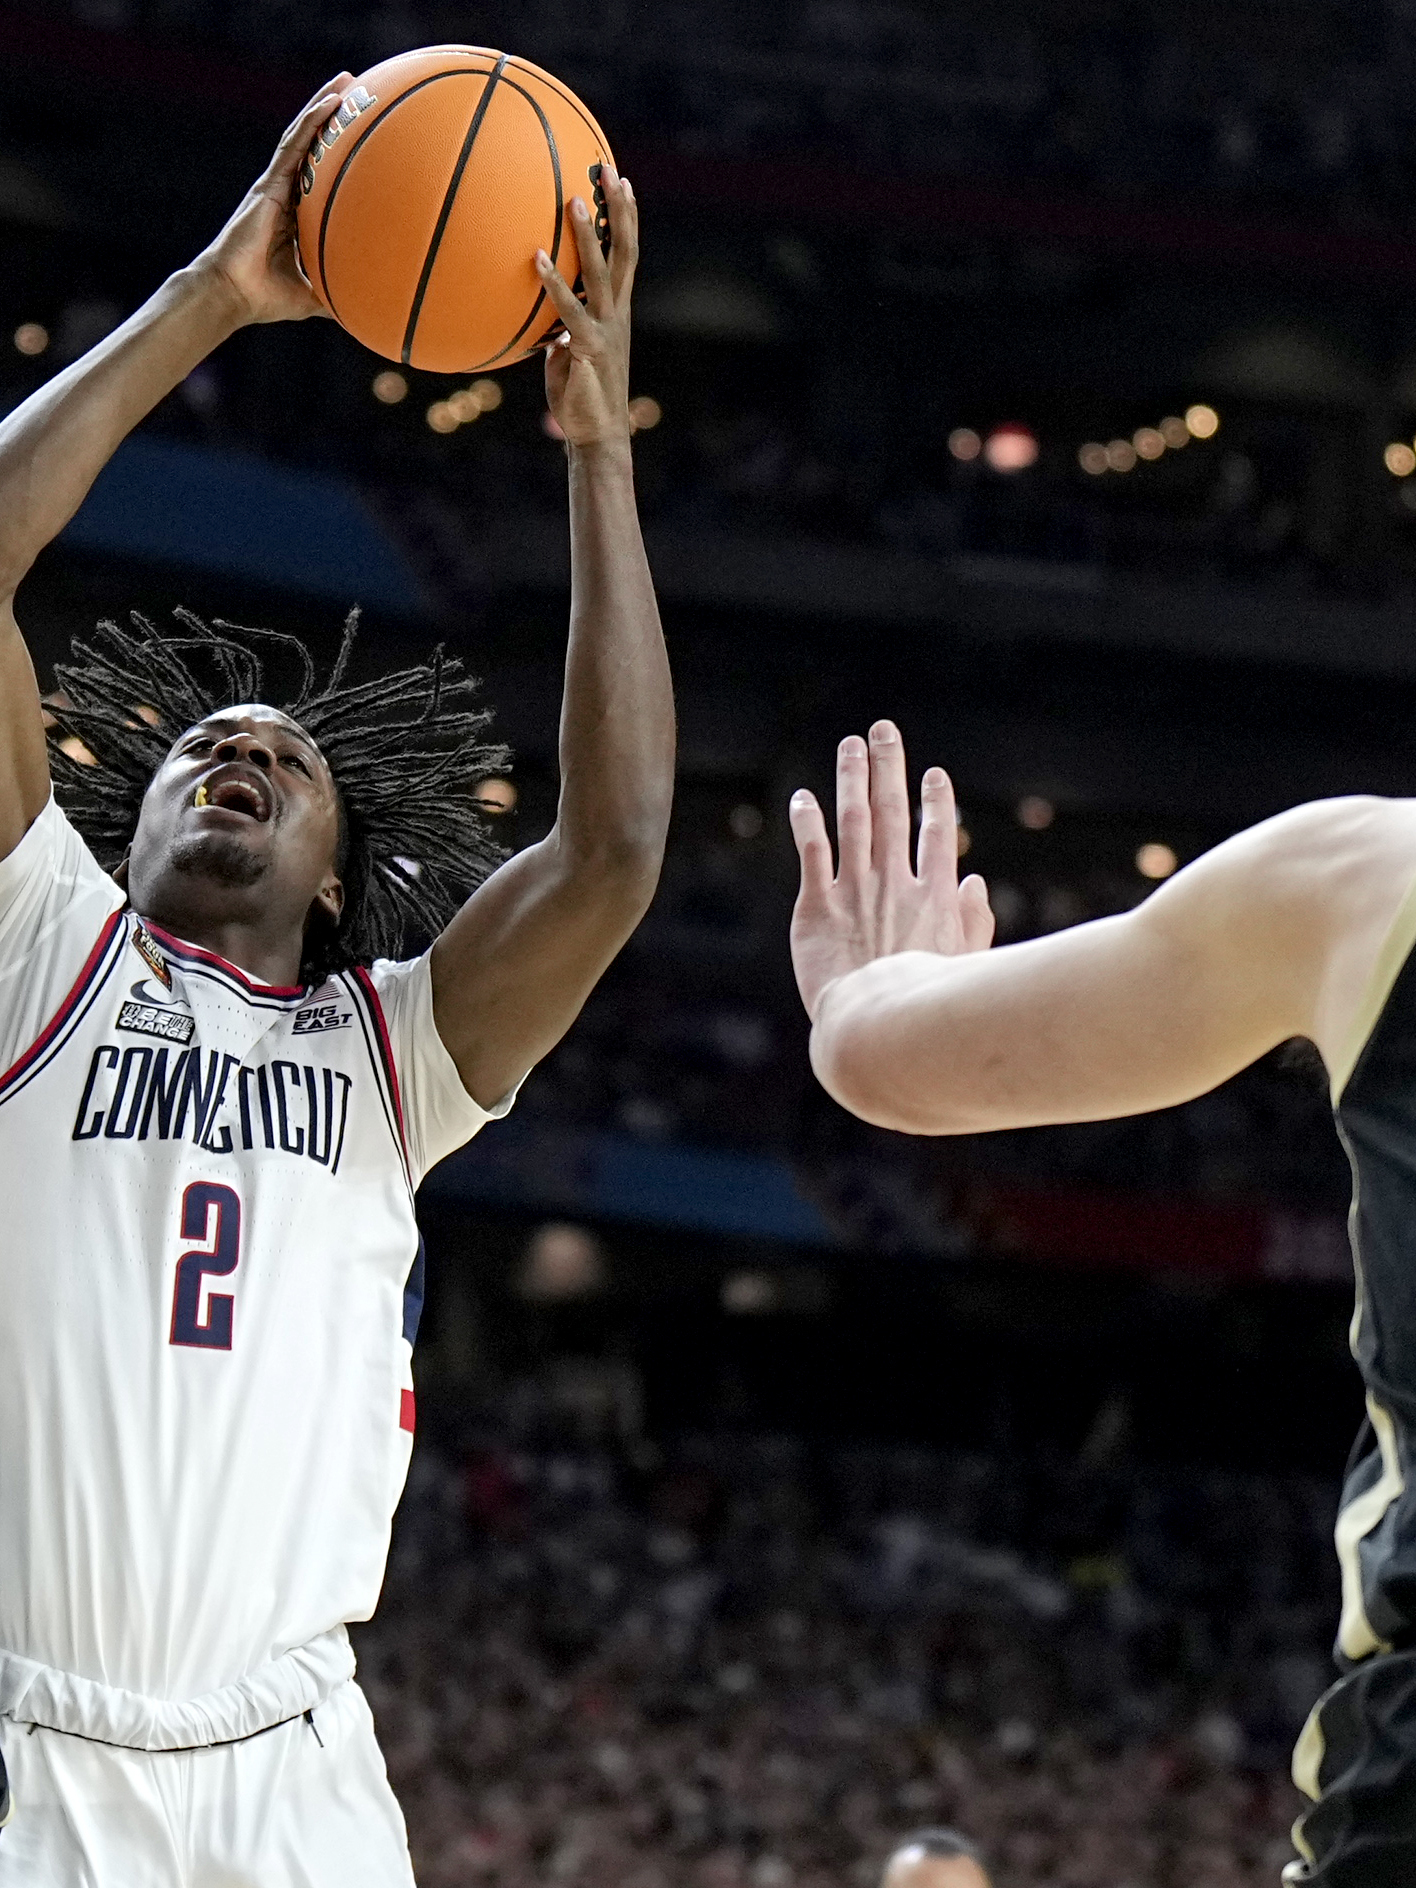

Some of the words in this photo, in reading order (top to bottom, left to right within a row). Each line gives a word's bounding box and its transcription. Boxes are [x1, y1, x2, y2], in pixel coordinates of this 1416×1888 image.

[292, 1013, 353, 1031] EAST
[295, 1005, 338, 1021] BIG
[118, 1017, 192, 1042] CHANGE
[169, 1180, 241, 1350] 2
